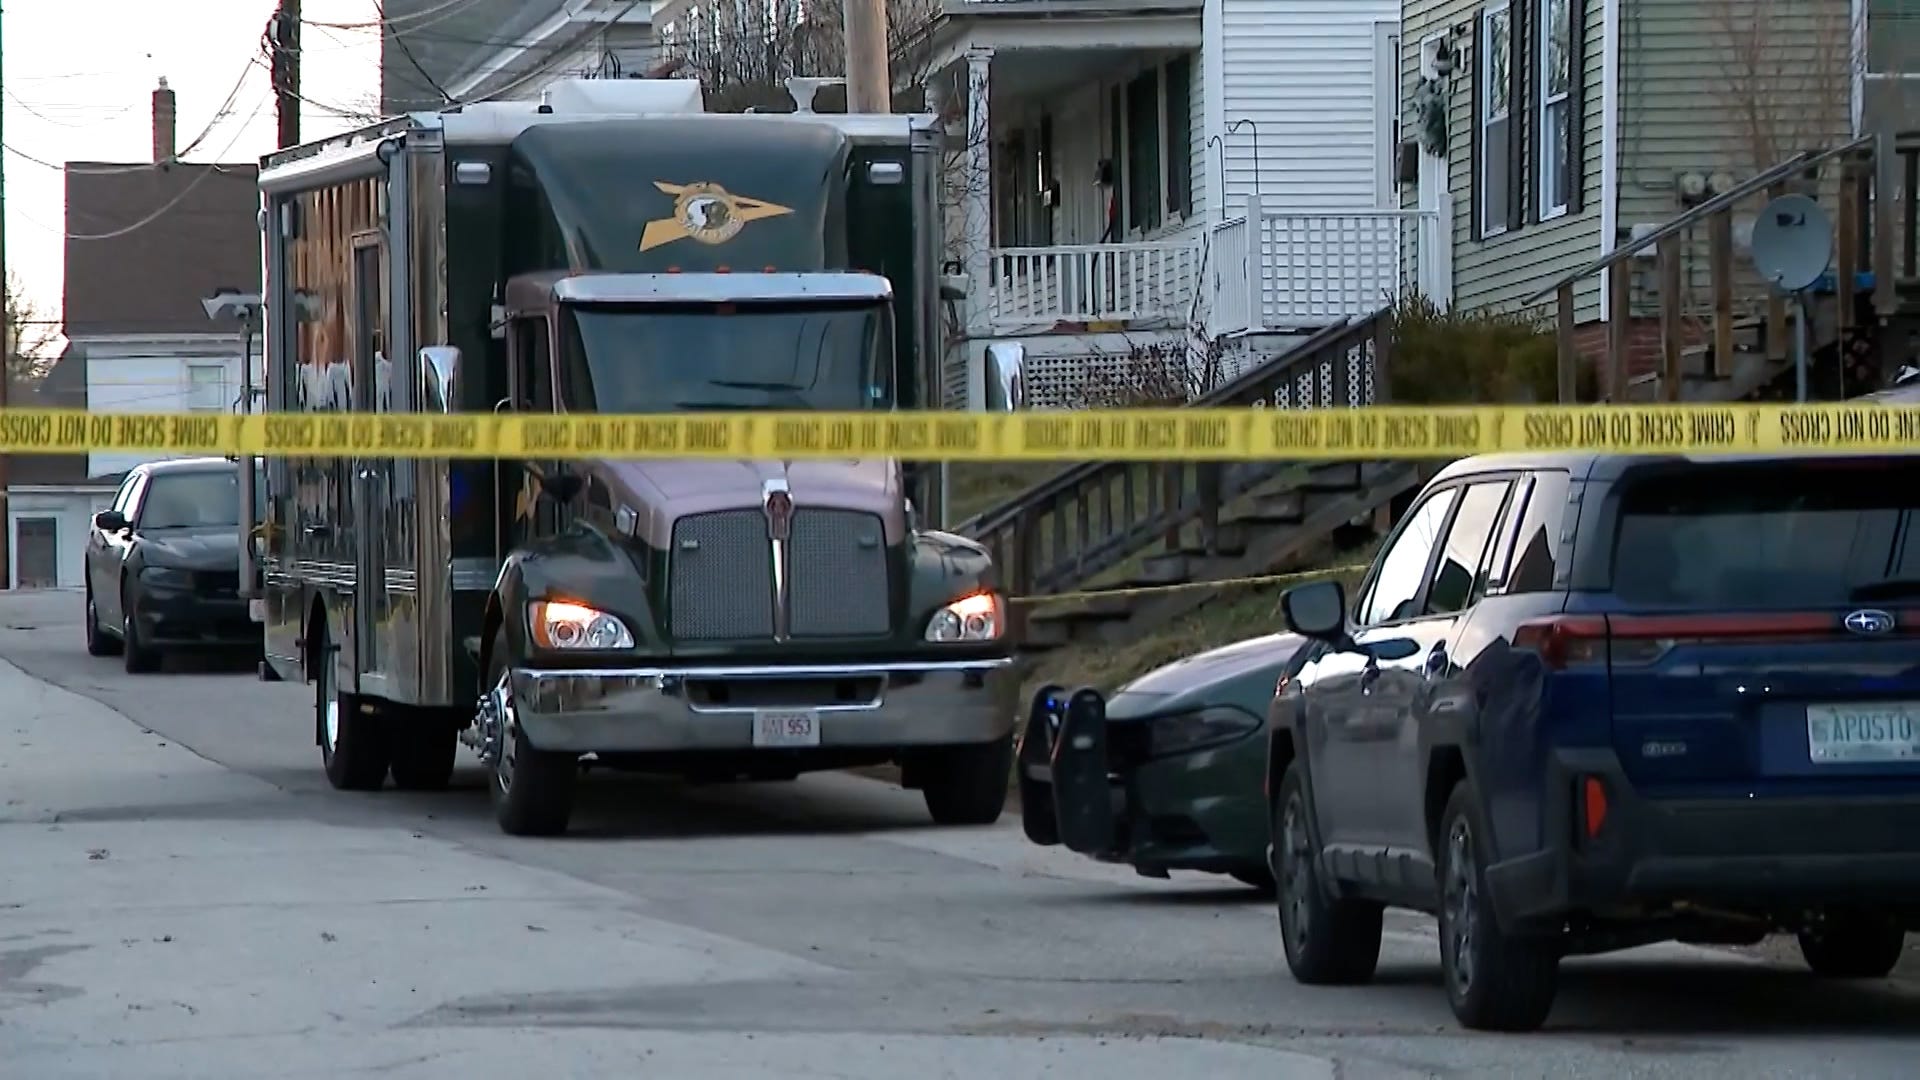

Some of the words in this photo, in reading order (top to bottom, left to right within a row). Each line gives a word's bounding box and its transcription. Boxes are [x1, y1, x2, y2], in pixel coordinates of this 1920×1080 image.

[0, 415, 50, 445] CROSS
[56, 415, 86, 445] NOT
[90, 415, 112, 446] DO
[117, 416, 165, 447] SCENE
[170, 416, 218, 447] CRIME
[264, 416, 314, 448] CROSS
[320, 416, 348, 448] NOT
[351, 416, 373, 448] DO
[379, 416, 426, 448] SCENE
[431, 417, 478, 448] CRIME
[1524, 414, 1573, 448] CROSS
[1579, 413, 1606, 447] NOT
[1611, 412, 1631, 447] DO
[1636, 411, 1683, 447] SCENE
[1688, 409, 1735, 446] CRIME
[1780, 410, 1830, 445] CROSS
[1836, 410, 1864, 443] NOT
[1869, 410, 1889, 442] DO
[1894, 410, 1920, 442] ENE
[1833, 712, 1912, 742] APOSTO
